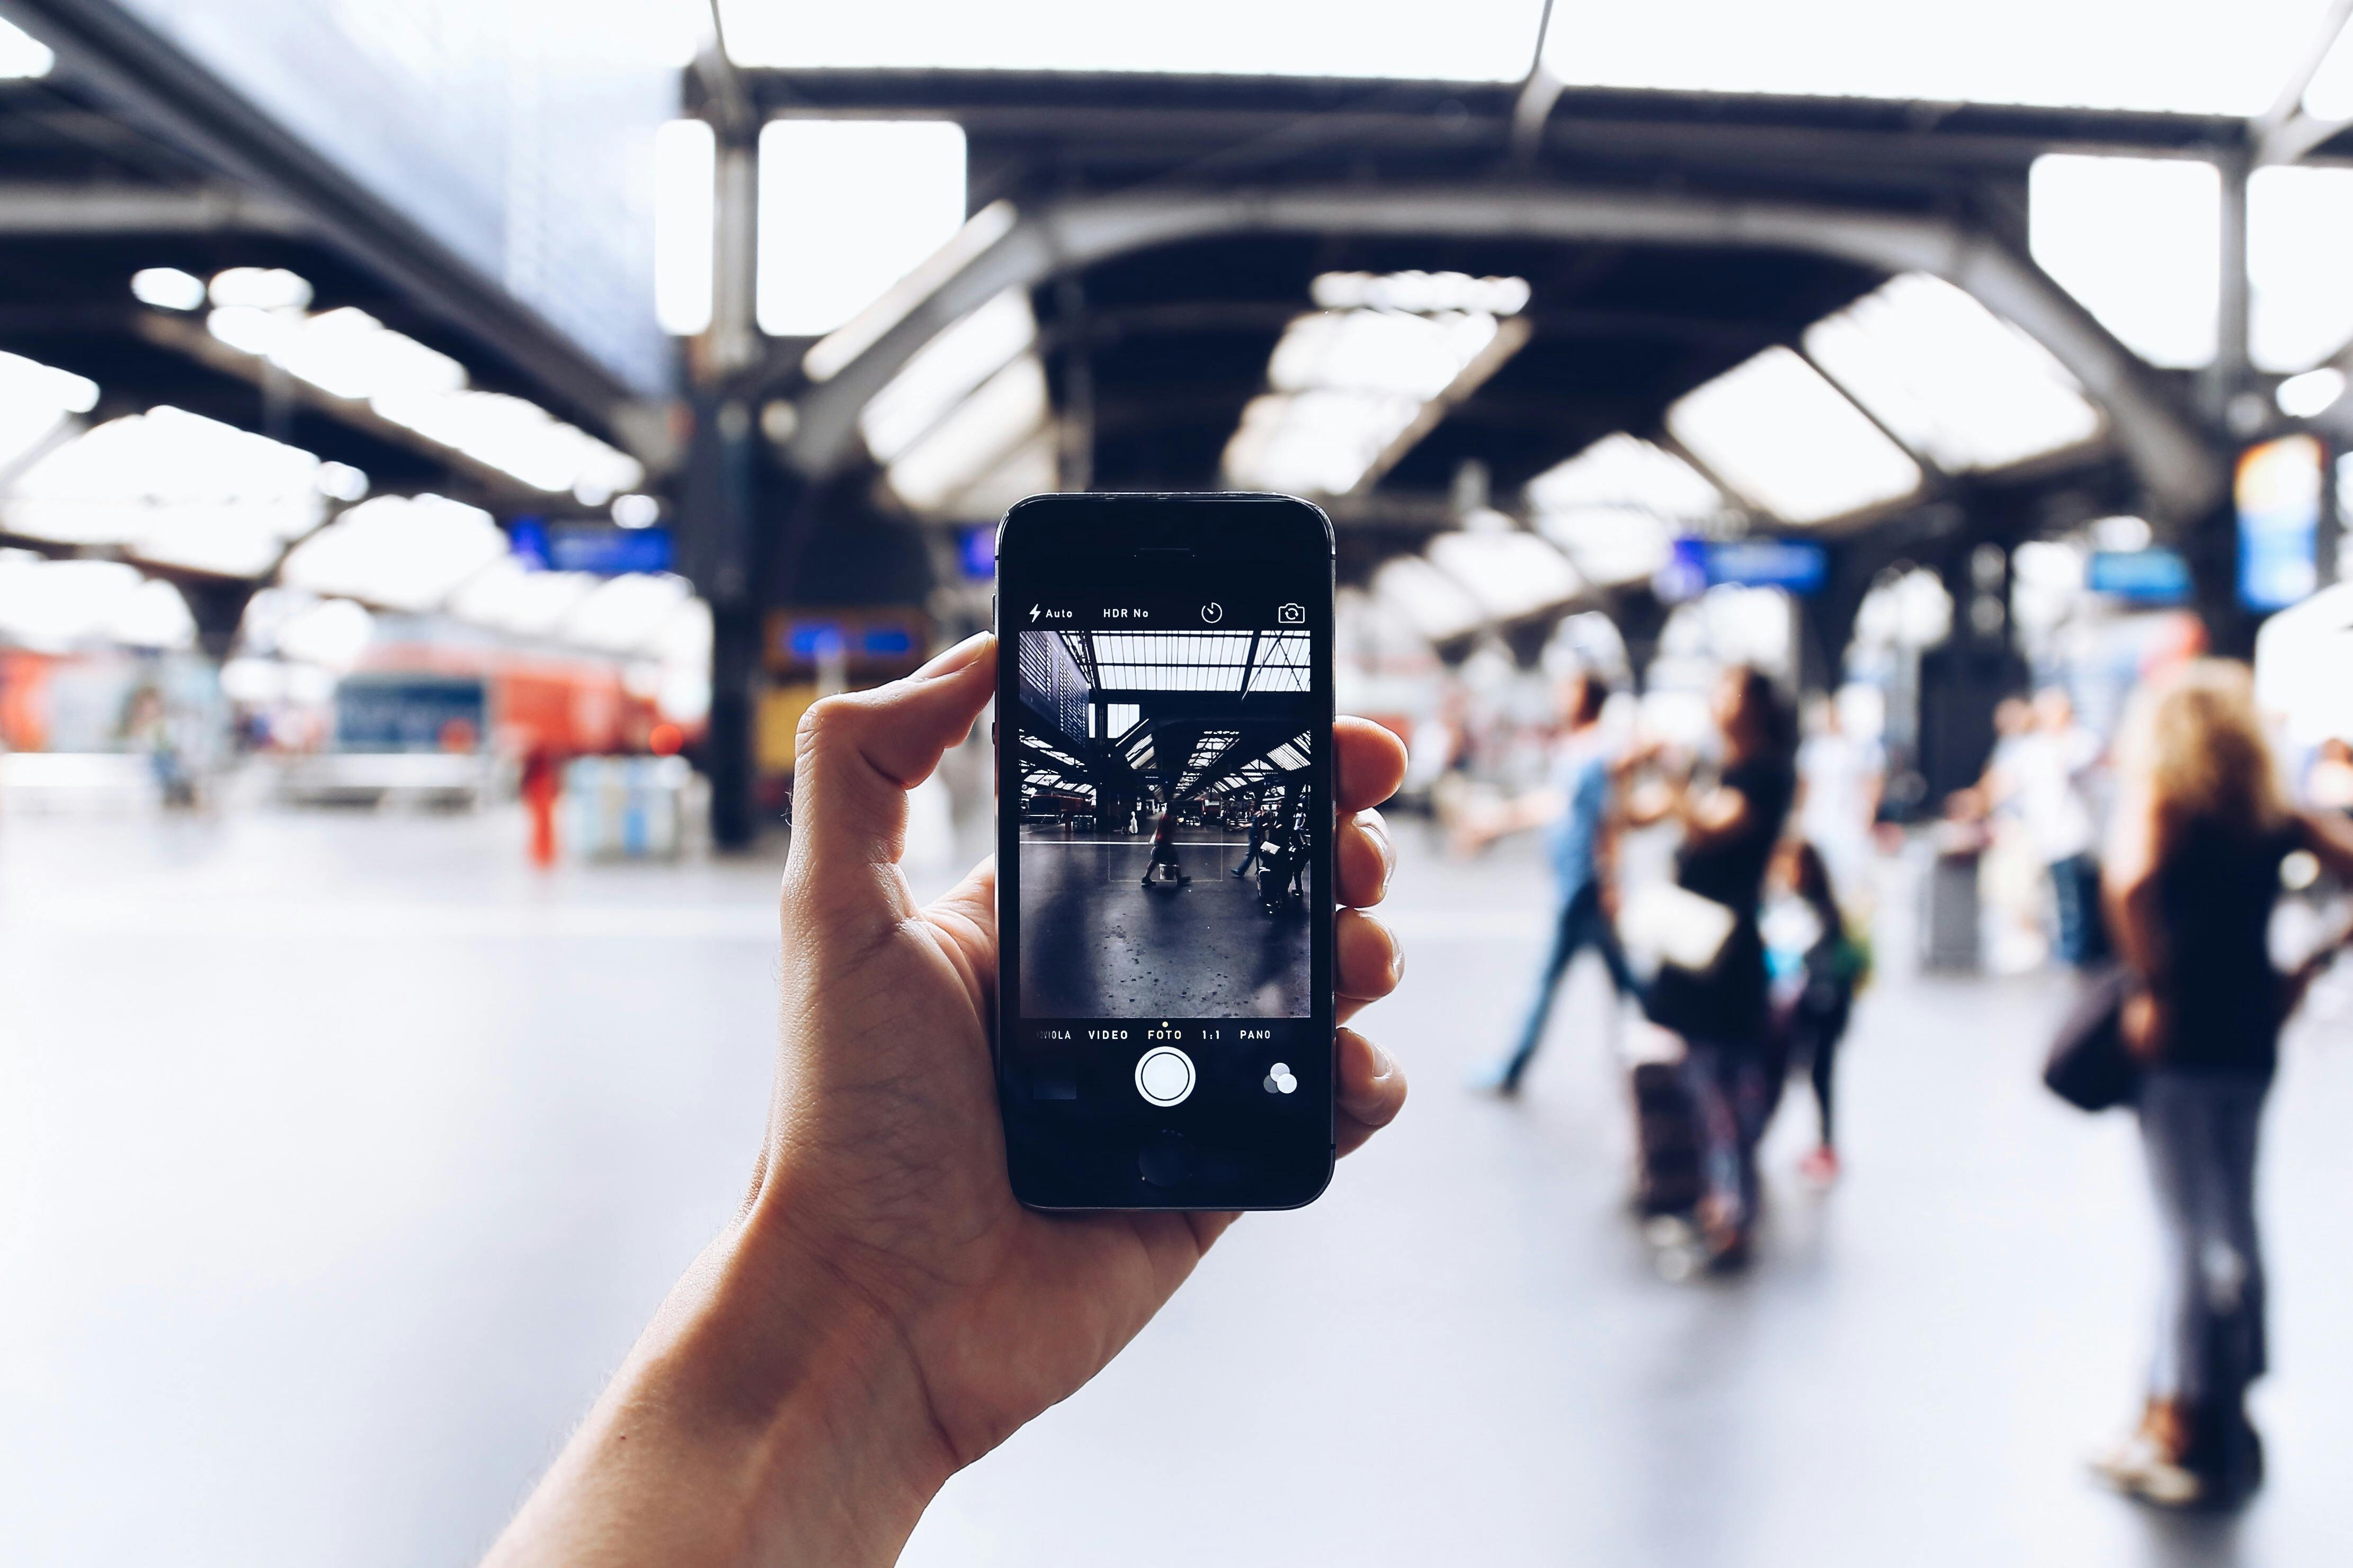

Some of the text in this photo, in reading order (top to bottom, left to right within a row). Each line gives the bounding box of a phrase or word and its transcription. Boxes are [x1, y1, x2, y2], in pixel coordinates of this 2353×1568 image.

[1045, 608, 1073, 618] Auto
[1103, 608, 1148, 618] HDR No
[1088, 1030, 1128, 1040] VIDEO
[1148, 1030, 1181, 1040] FOTO
[1202, 1030, 1219, 1040] 1:1
[1240, 1030, 1270, 1040] PANO
